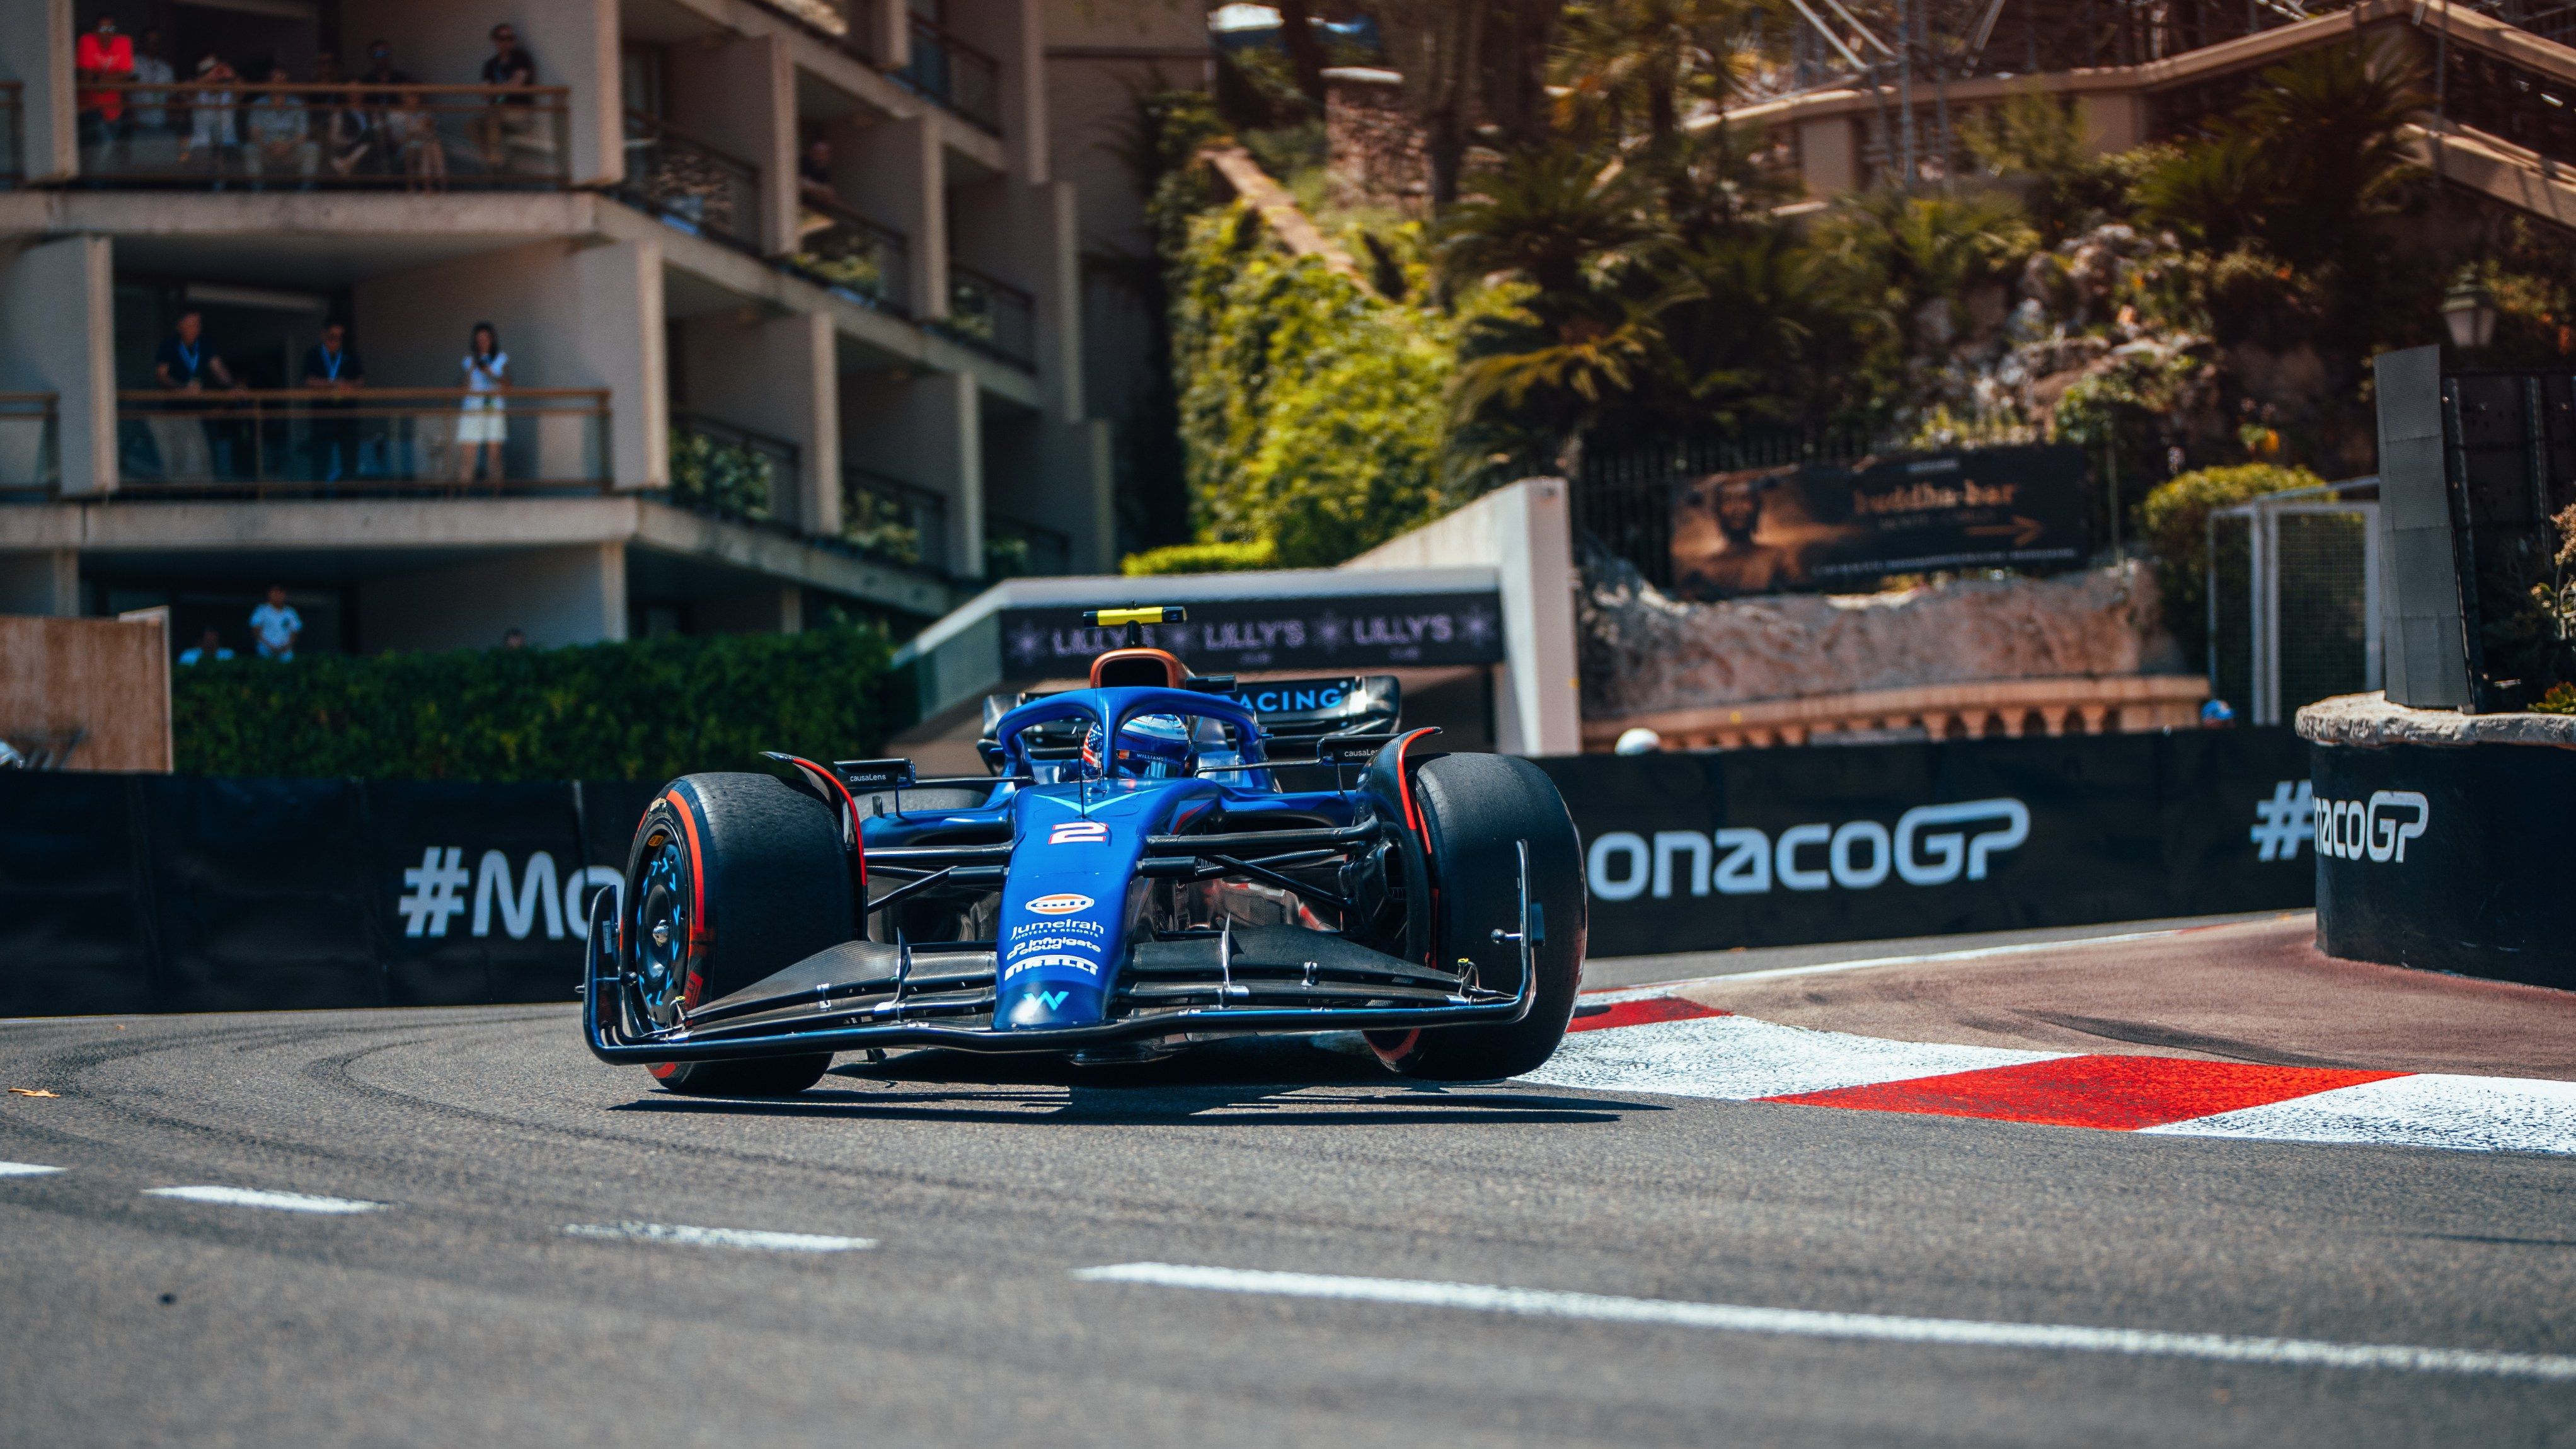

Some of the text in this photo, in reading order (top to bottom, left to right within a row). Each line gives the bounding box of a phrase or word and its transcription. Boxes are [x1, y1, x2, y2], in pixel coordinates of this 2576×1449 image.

[1217, 688, 1343, 712] ACING
[1137, 753, 1164, 761] WILLIAMS
[850, 773, 886, 782] causaLens
[1048, 822, 1109, 845] 2
[2312, 790, 2429, 863] nacoGP
[1575, 797, 2030, 901] onacoGP
[1009, 918, 1104, 941] Jumeirah
[1004, 954, 1098, 981] PIRELLI
